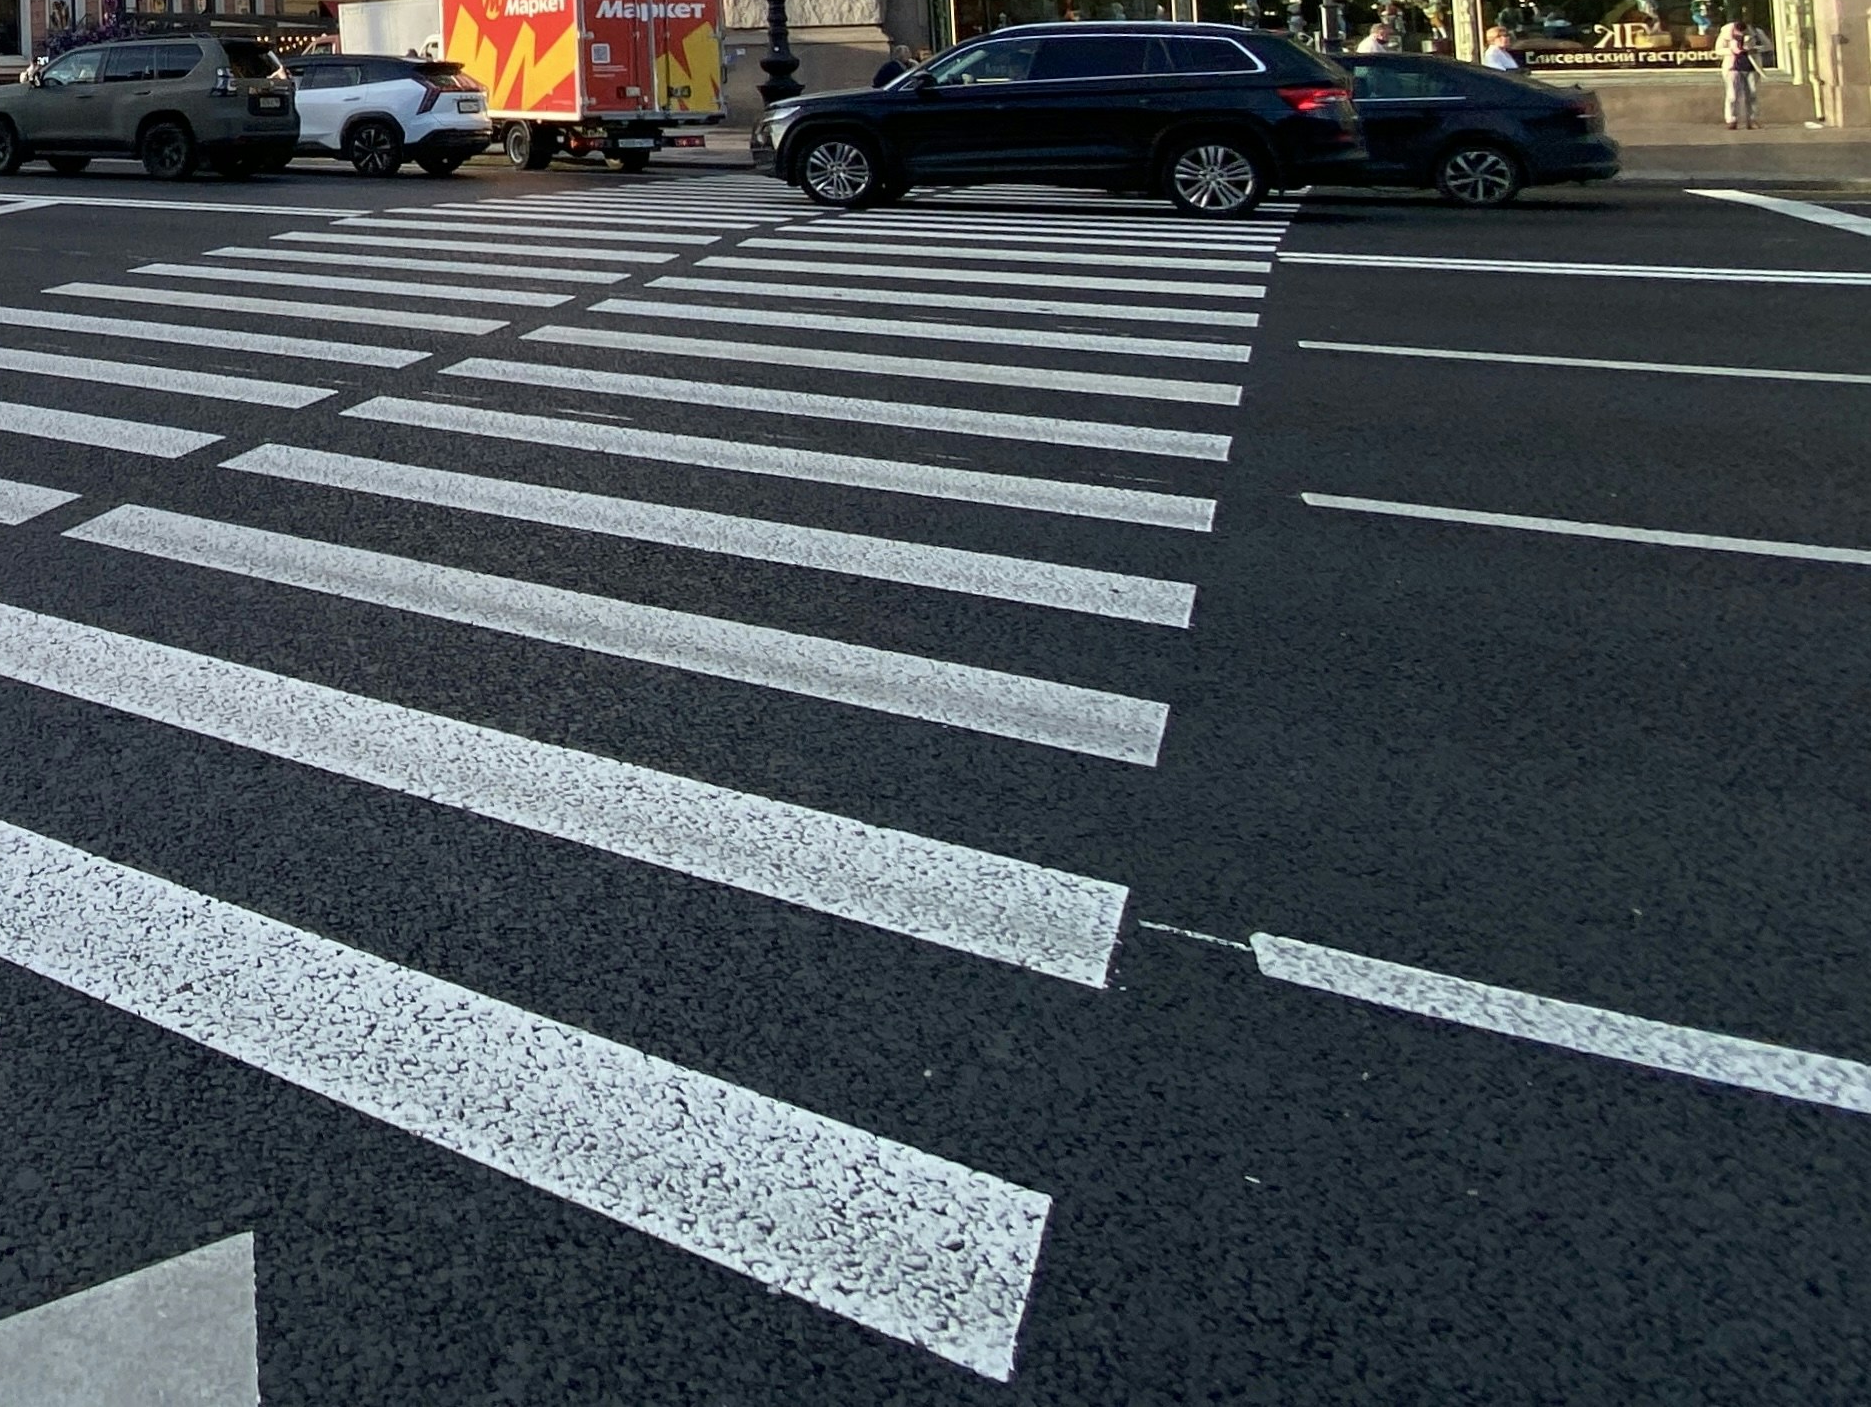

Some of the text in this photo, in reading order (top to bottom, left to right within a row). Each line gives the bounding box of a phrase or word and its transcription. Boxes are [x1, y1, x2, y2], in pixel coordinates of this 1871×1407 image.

[595, 0, 706, 22] Маркет
[1525, 49, 1724, 65] Елисеевский гастроно
